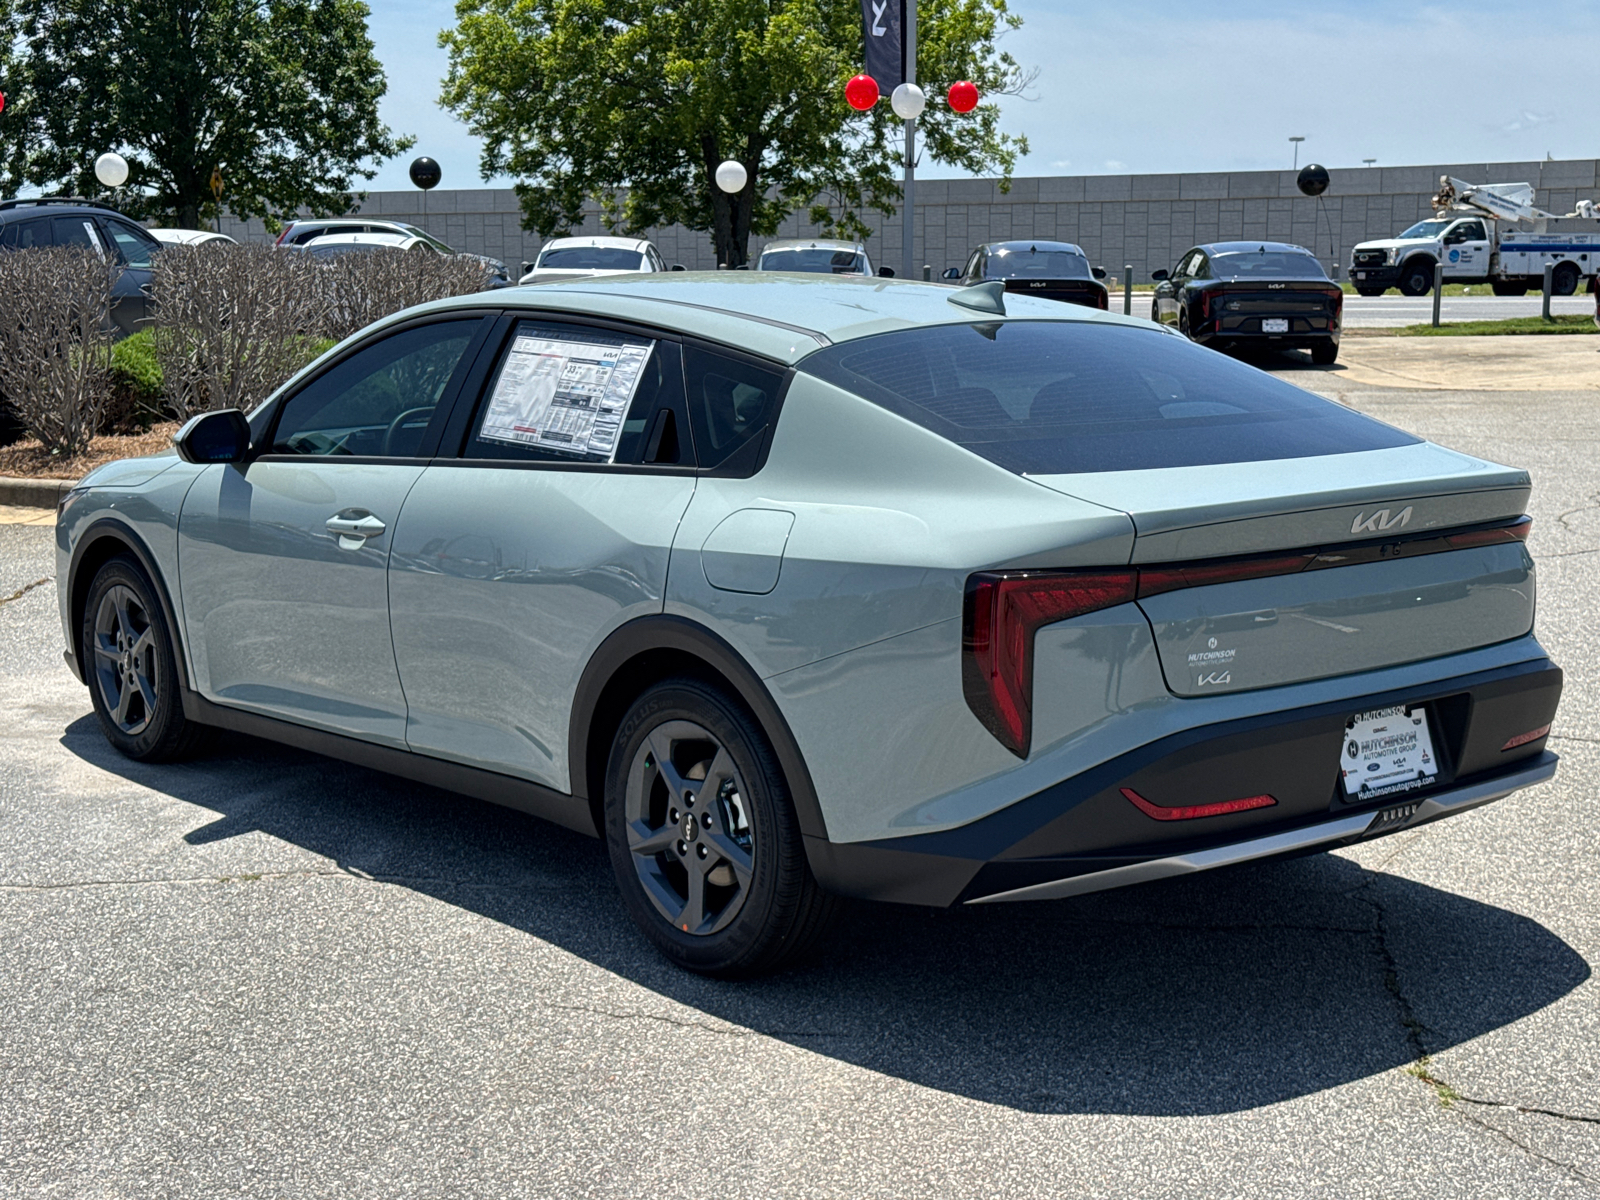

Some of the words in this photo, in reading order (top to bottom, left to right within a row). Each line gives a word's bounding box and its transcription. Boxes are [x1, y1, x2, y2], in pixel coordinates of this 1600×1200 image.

[1351, 506, 1413, 534] KIA
[1187, 648, 1237, 662] HUTCHINSON
[1197, 670, 1231, 687] K4
[1363, 705, 1406, 721] HUTCHINSON
[618, 699, 659, 747] SOLUS
[1361, 731, 1418, 753] HUTCHINSON
[1363, 747, 1398, 761] AUTOMOTIVE
[1399, 743, 1417, 753] GROUP
[1392, 757, 1407, 765] KIA
[1357, 776, 1435, 801] Hutchinsonautogroup.com
